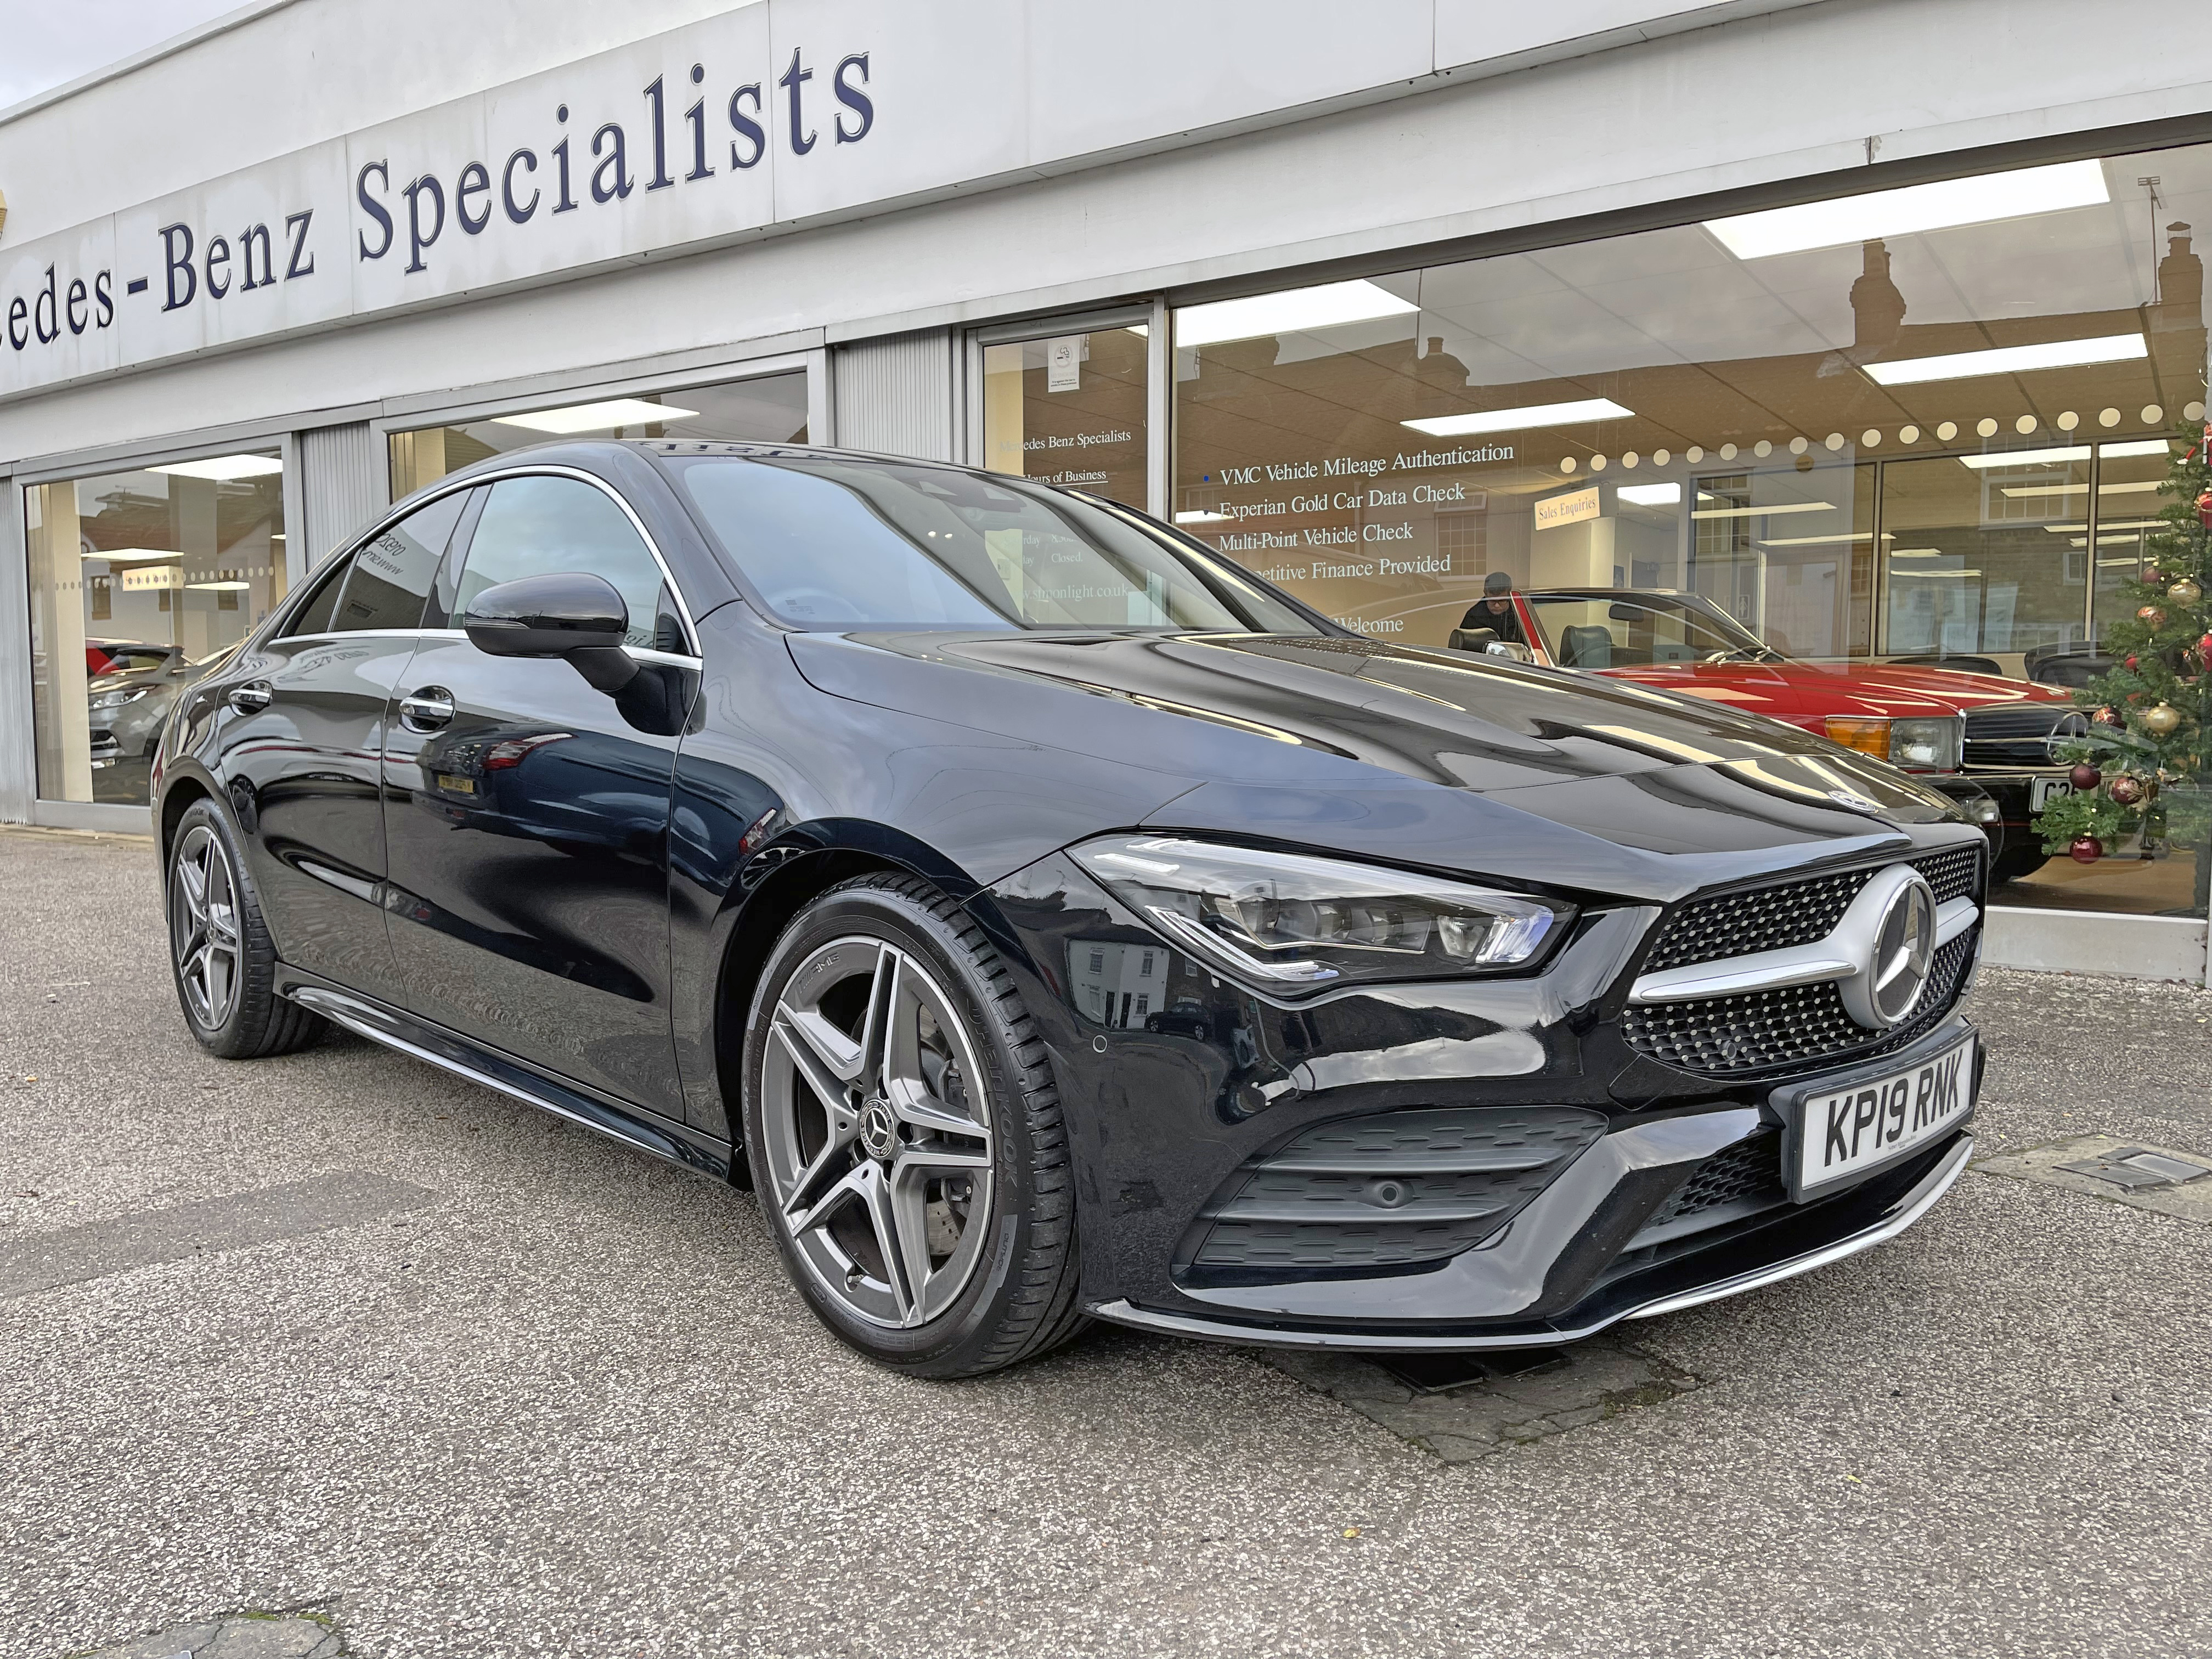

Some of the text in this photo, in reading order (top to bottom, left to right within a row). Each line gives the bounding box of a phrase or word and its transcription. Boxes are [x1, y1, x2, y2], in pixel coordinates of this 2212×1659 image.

[0, 46, 875, 351] edes-Benz Specialists
[1048, 436, 1074, 448] Benz
[1077, 430, 1131, 448] Specialists
[1053, 471, 1063, 483] of
[1065, 470, 1106, 482] Business
[1220, 443, 1514, 486] VMC Vehicle Mileage Authentication
[1220, 482, 1465, 522] Experian Gold Car Data Check
[1539, 496, 1596, 520] Sales Enquiries
[1219, 522, 1413, 551] Multi-Point Vehicle Check
[1051, 552, 1084, 563] Closed.
[1312, 562, 1373, 579] Finance
[1379, 554, 1451, 575] Provided
[1023, 583, 1129, 602] w.simonlight.co.uk
[1824, 1048, 1963, 1167] KP19 RNK
